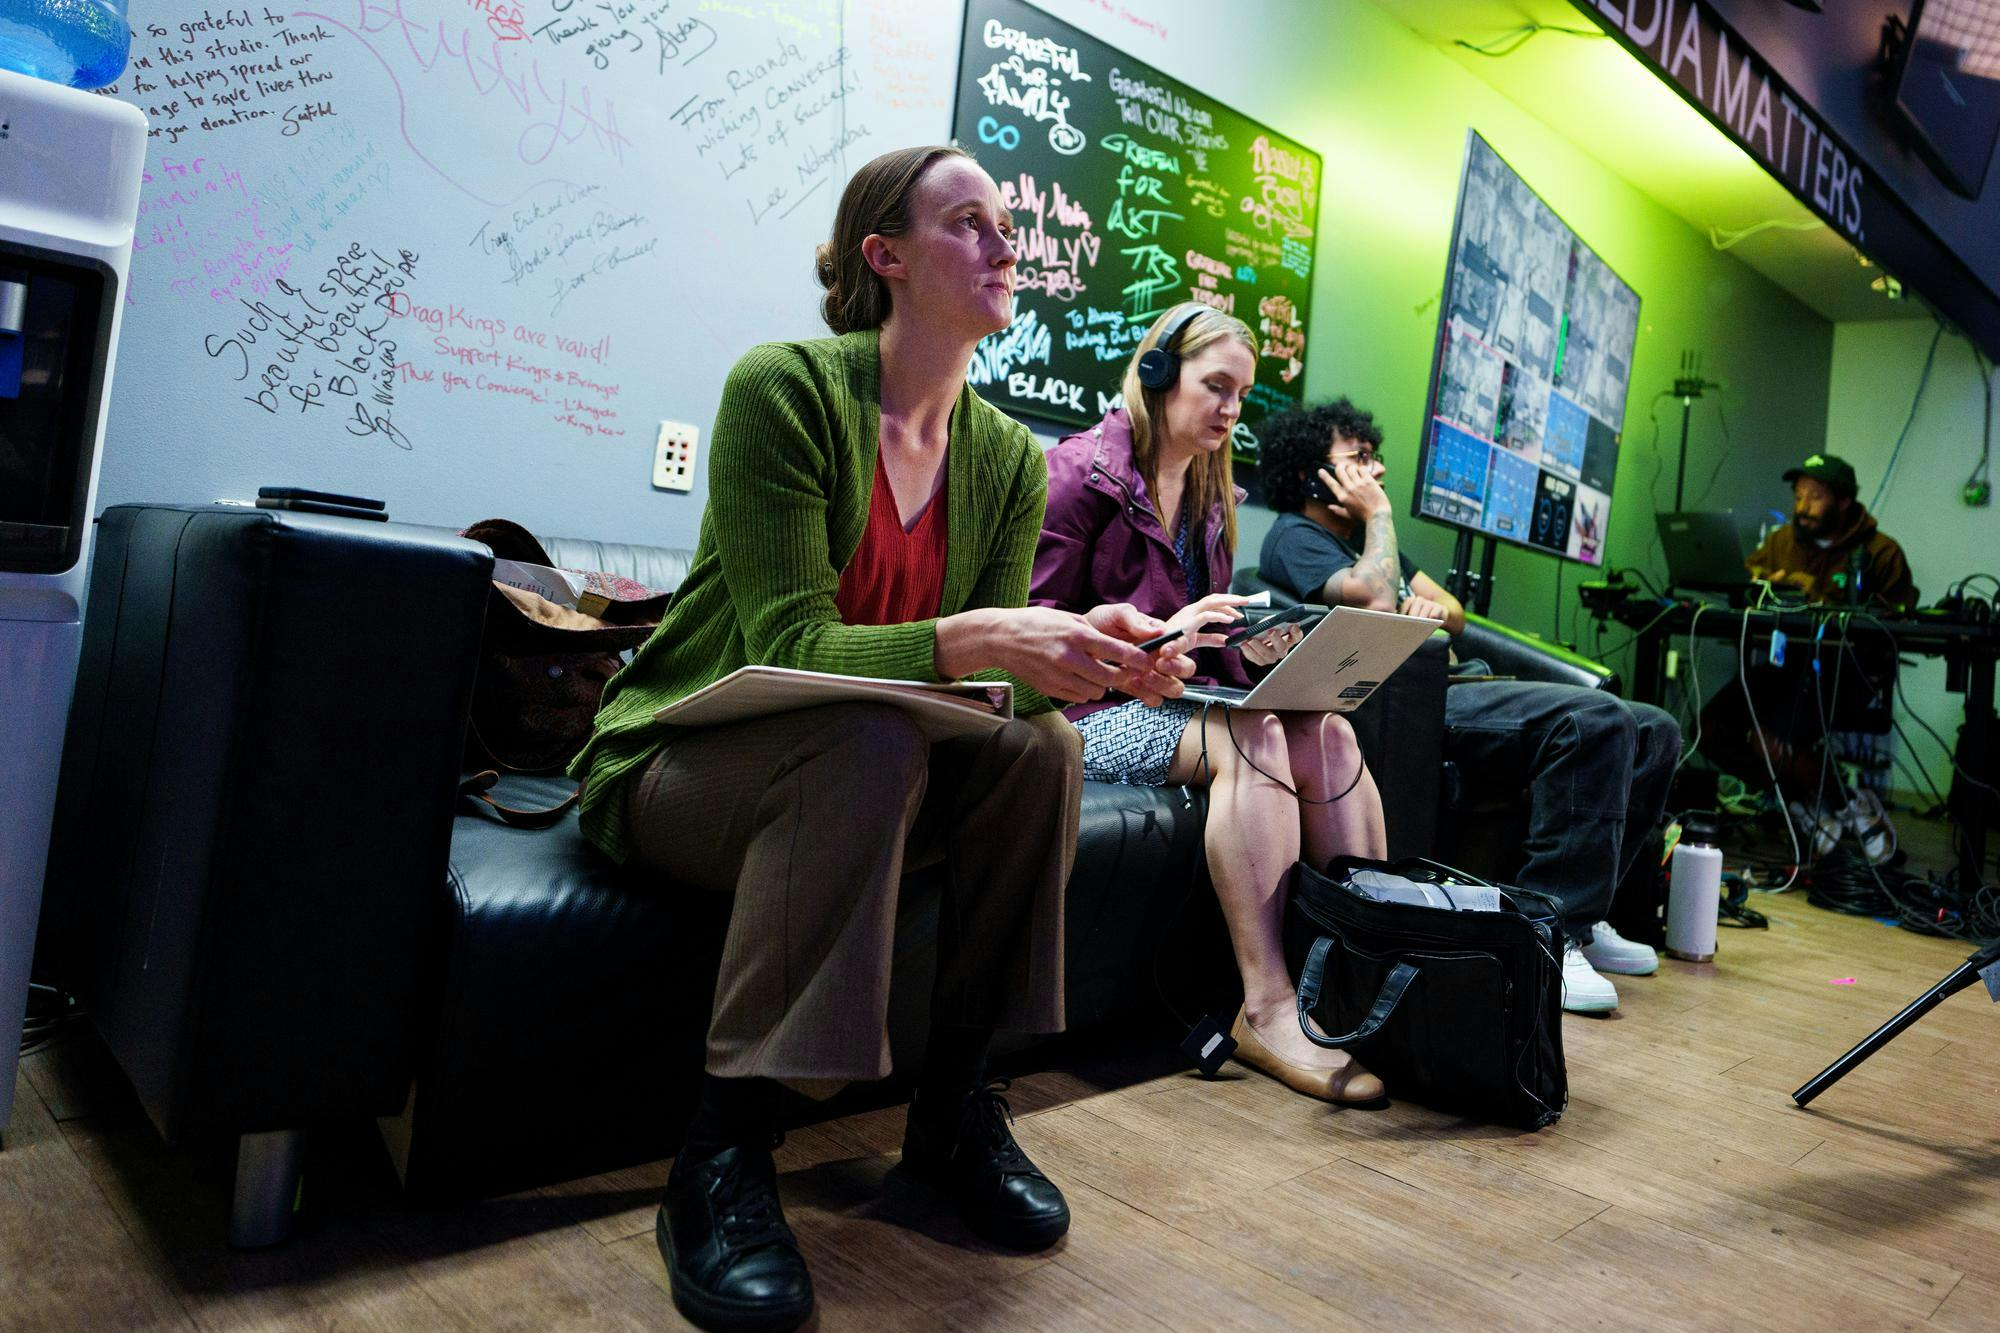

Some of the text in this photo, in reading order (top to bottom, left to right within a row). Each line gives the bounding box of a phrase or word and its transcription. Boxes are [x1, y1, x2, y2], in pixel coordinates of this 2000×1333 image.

[159, 46, 194, 67] this
[273, 24, 335, 47] Thank
[180, 9, 253, 43] grateful
[263, 7, 285, 27] to
[532, 16, 599, 46] Thank
[586, 29, 643, 70] giving
[132, 77, 158, 95] for
[183, 90, 205, 108] to
[256, 80, 294, 98] lives
[298, 70, 333, 88] thru
[669, 94, 726, 132] From
[1146, 108, 1184, 145] OUR
[767, 121, 789, 148] of
[1712, 30, 1865, 242] MATTERS.
[205, 298, 291, 381] Such
[387, 291, 611, 366] Drag Kings are valid!
[328, 317, 389, 396] Black
[434, 336, 502, 367] Support
[506, 355, 551, 383] Kings
[289, 369, 325, 413] for
[1008, 372, 1086, 413] BLACK
